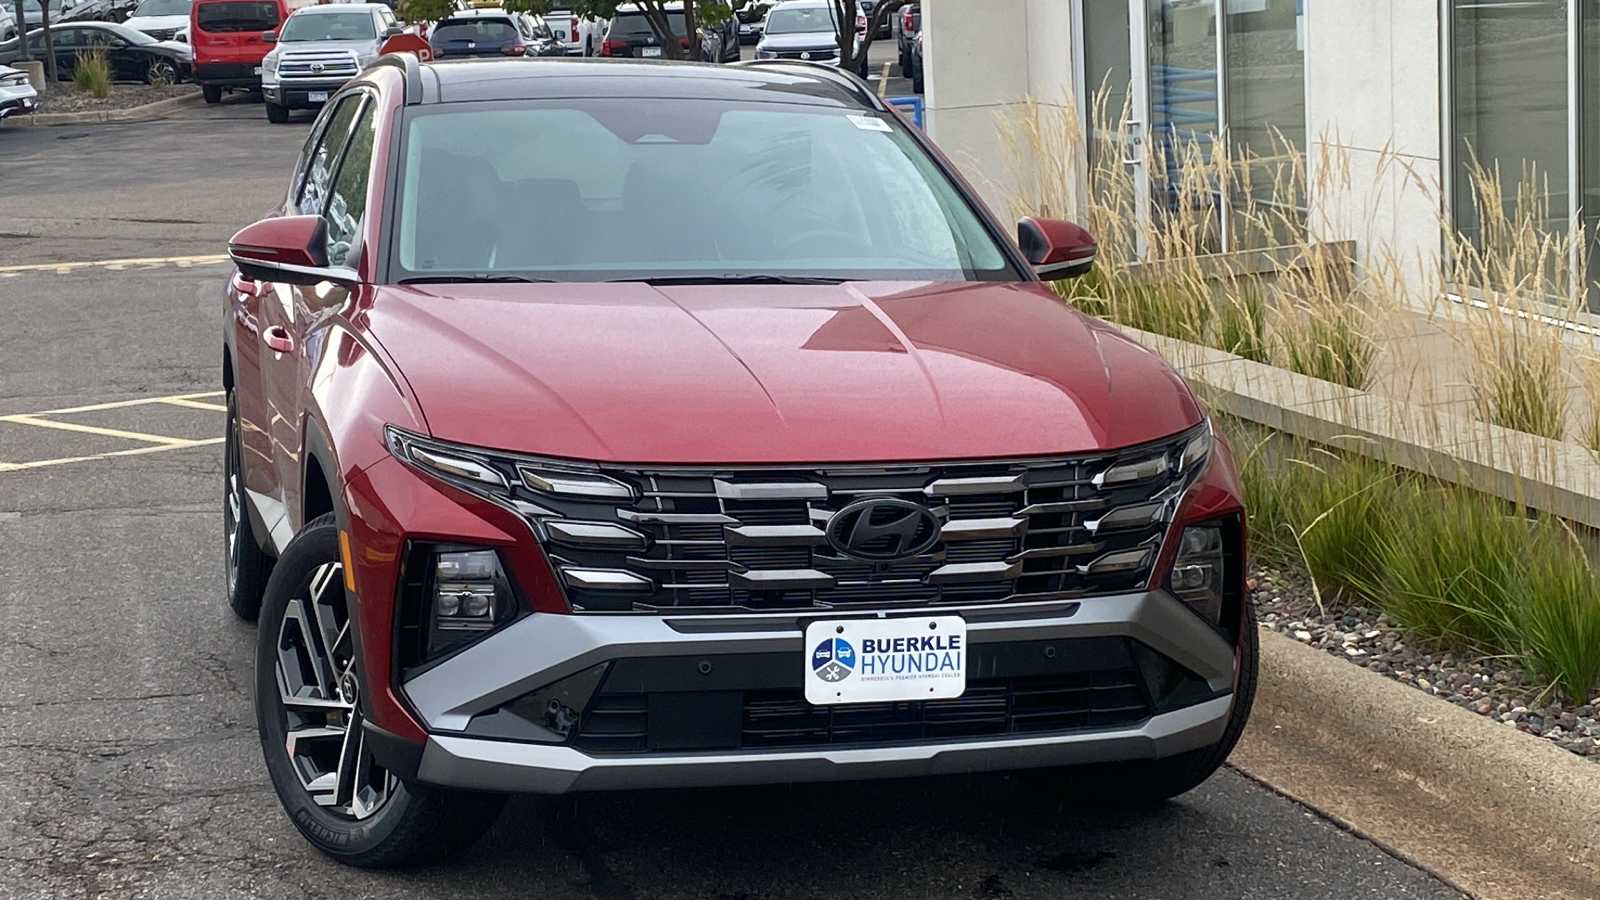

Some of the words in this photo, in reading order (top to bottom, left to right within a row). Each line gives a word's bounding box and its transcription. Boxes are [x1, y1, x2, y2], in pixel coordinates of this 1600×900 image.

[862, 635, 961, 654] BUERKLE
[861, 651, 961, 675] HYUNDAI
[297, 810, 349, 845] MICHELIN
